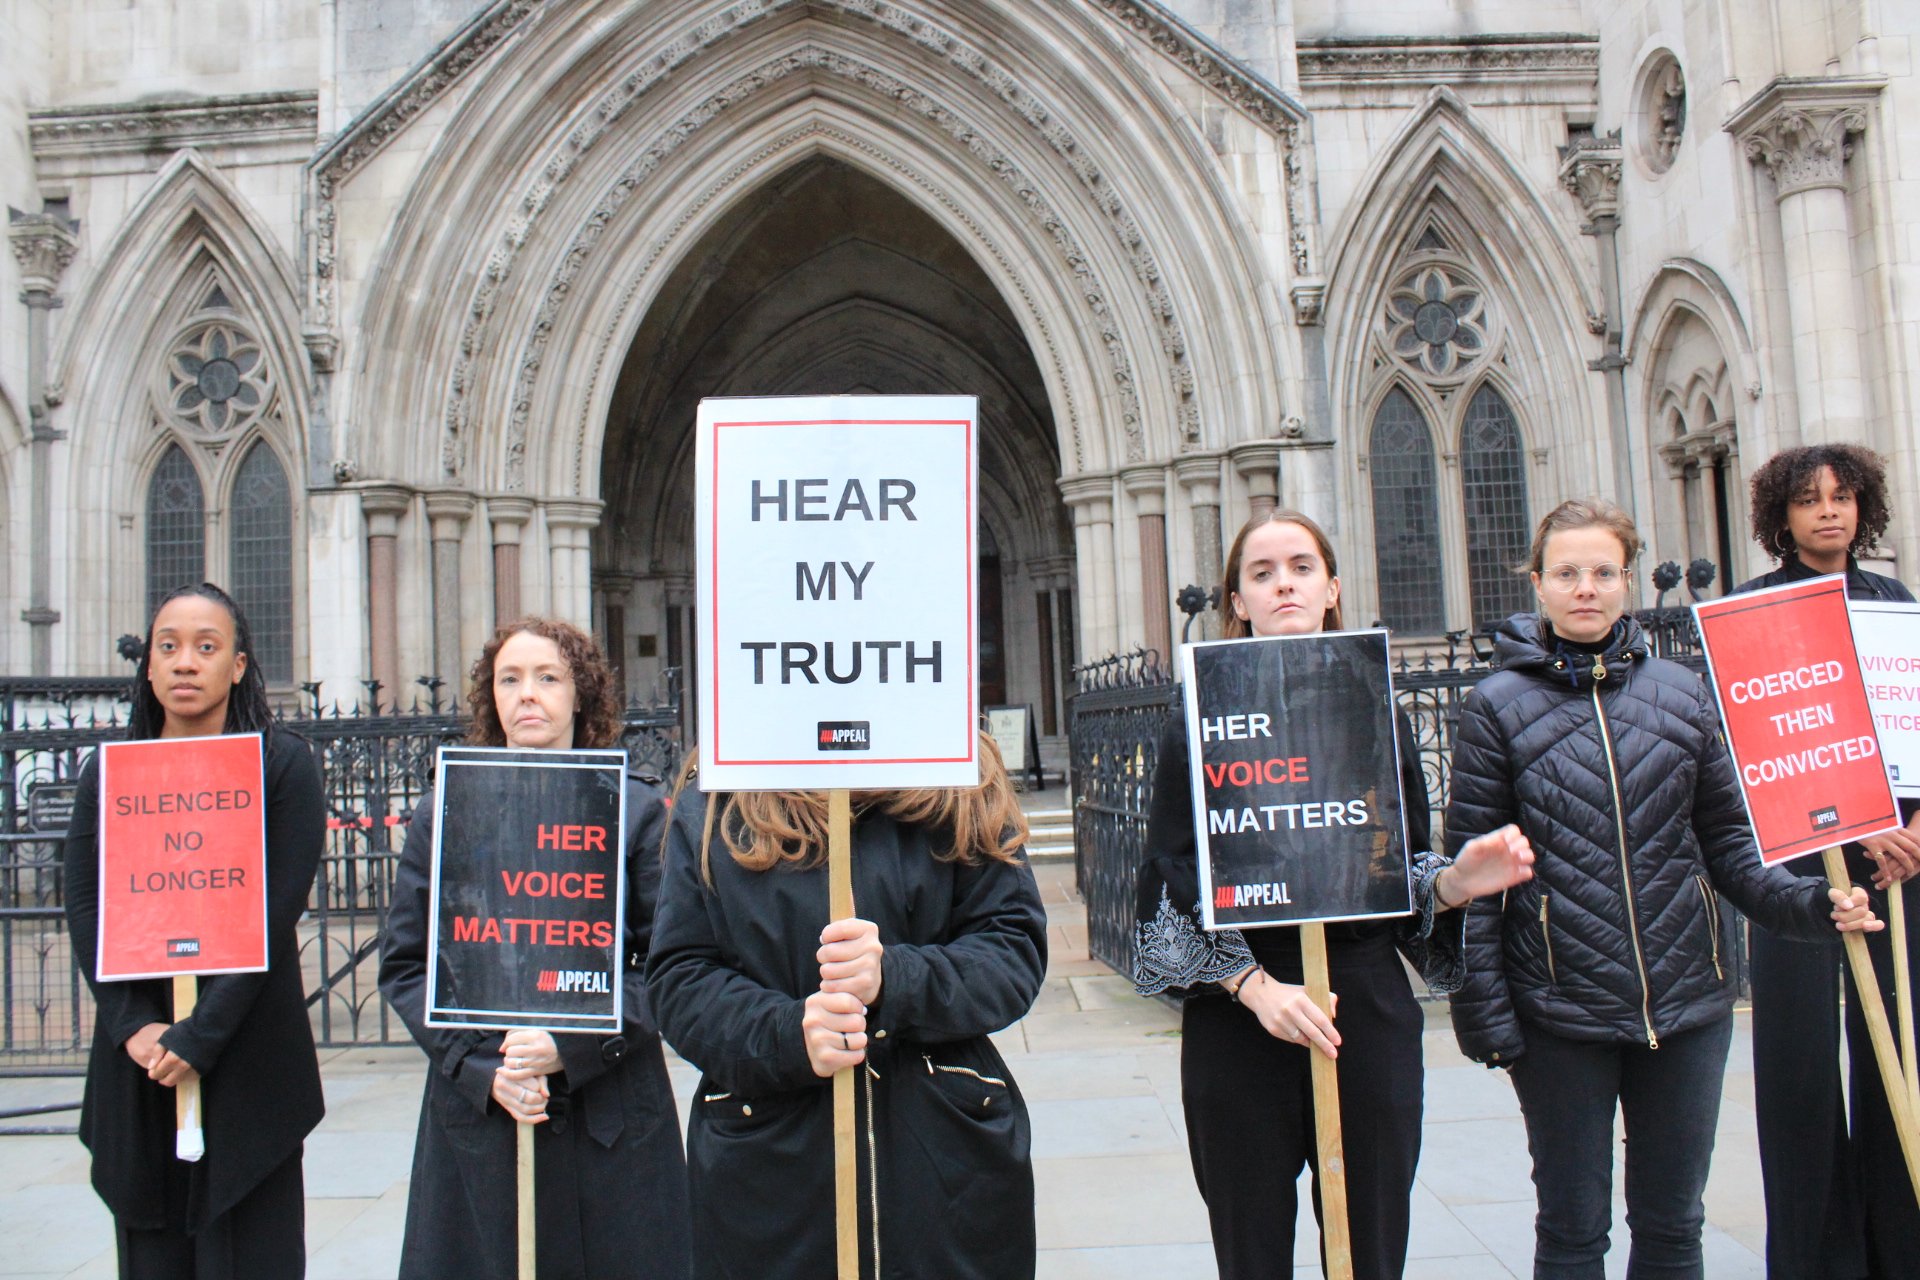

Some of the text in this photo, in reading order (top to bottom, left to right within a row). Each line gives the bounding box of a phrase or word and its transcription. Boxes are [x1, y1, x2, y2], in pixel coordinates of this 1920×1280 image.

[751, 478, 918, 522] HEAR
[796, 561, 875, 601] MY
[741, 640, 942, 685] TRUTH
[1730, 660, 1843, 704] COERCED
[1867, 685, 1920, 701] SERV
[1202, 713, 1272, 742] HER
[1770, 703, 1834, 736] THEN
[1875, 714, 1920, 731] TICE
[832, 729, 867, 743] APPEAL
[1204, 757, 1309, 788] VOICE
[1743, 735, 1876, 787] CONVICTED
[115, 789, 251, 816] SILENCED
[1209, 799, 1368, 835] MATTERS
[164, 831, 204, 852] NO
[537, 824, 606, 852] HER
[130, 868, 245, 893] LONGER
[502, 871, 605, 899] VOICE
[1234, 882, 1291, 907] APPEAL
[453, 916, 614, 947] MATTERS
[556, 970, 610, 993] APPEAL
